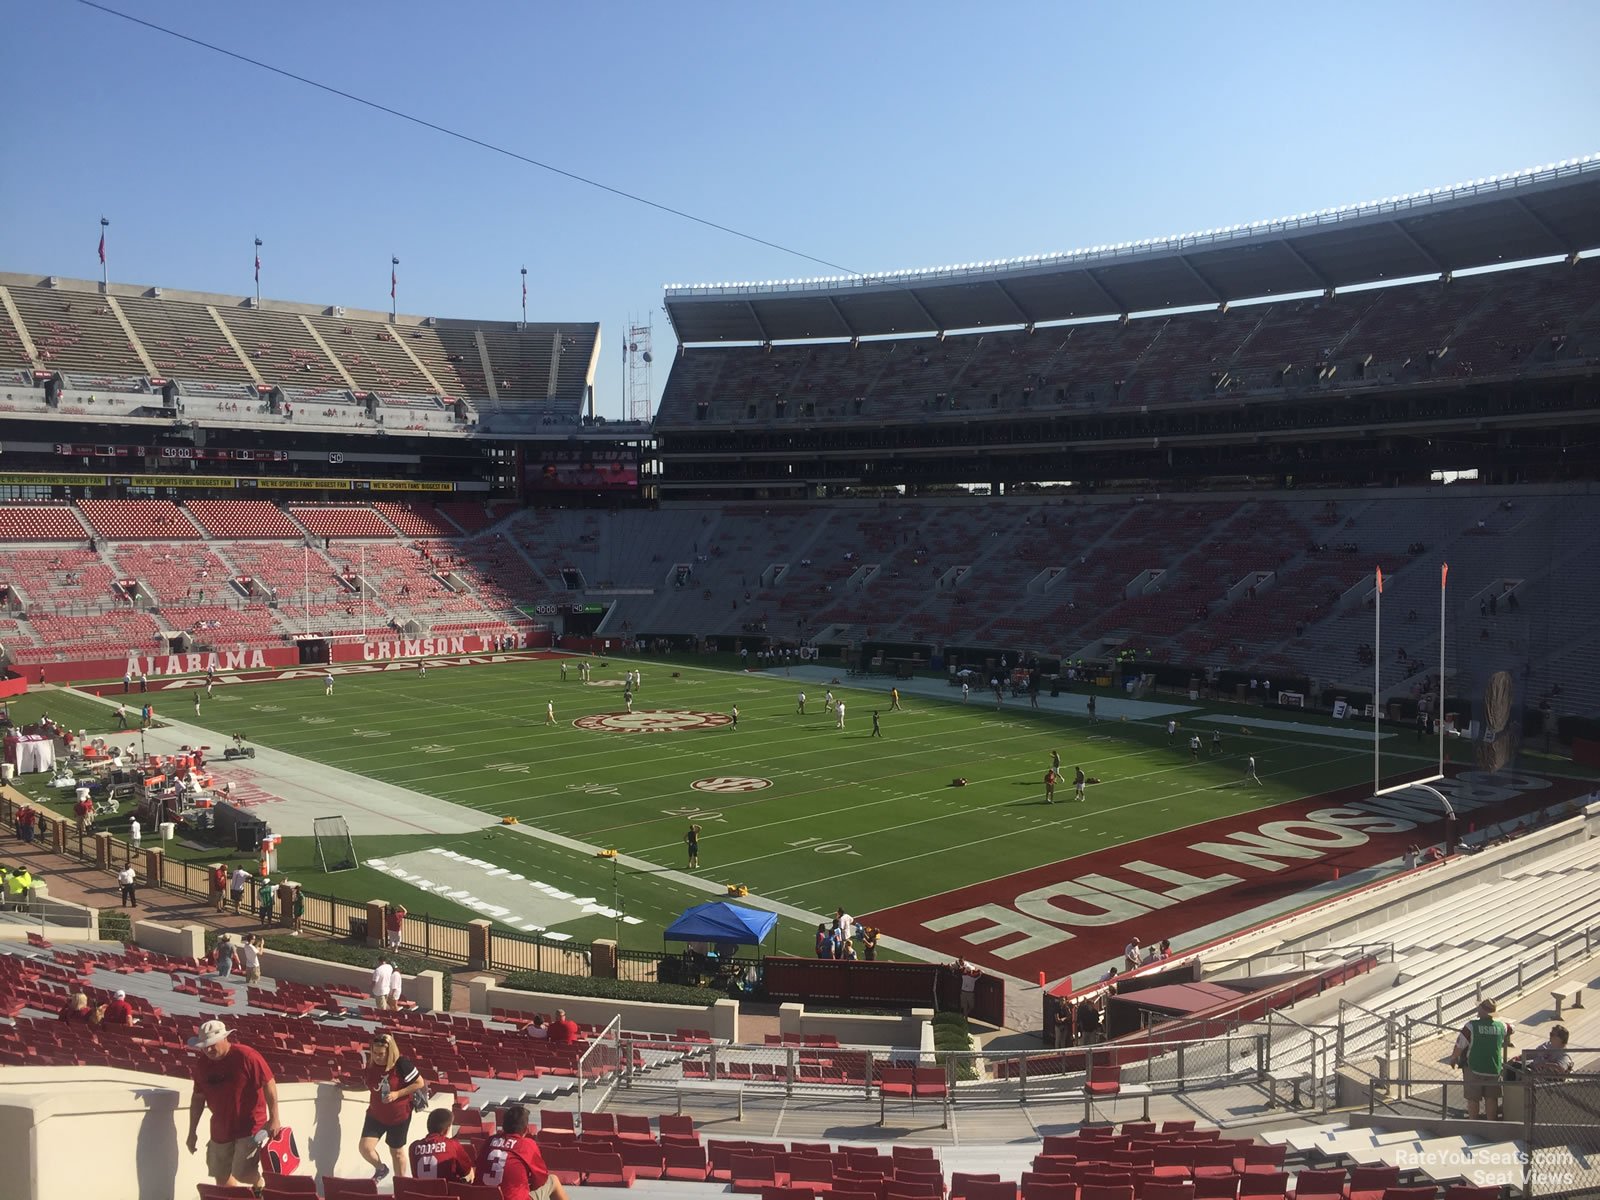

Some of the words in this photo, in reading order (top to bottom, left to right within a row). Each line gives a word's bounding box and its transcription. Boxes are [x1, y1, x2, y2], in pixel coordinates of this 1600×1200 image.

[363, 636, 467, 660] CRIMSON
[126, 649, 266, 677] ALABAMA
[160, 654, 540, 691] ALABAMA
[661, 806, 723, 820] 20
[783, 837, 852, 853] 10
[919, 860, 1247, 960] TIDE
[415, 1142, 446, 1155] COOPER
[482, 1149, 508, 1185] 3
